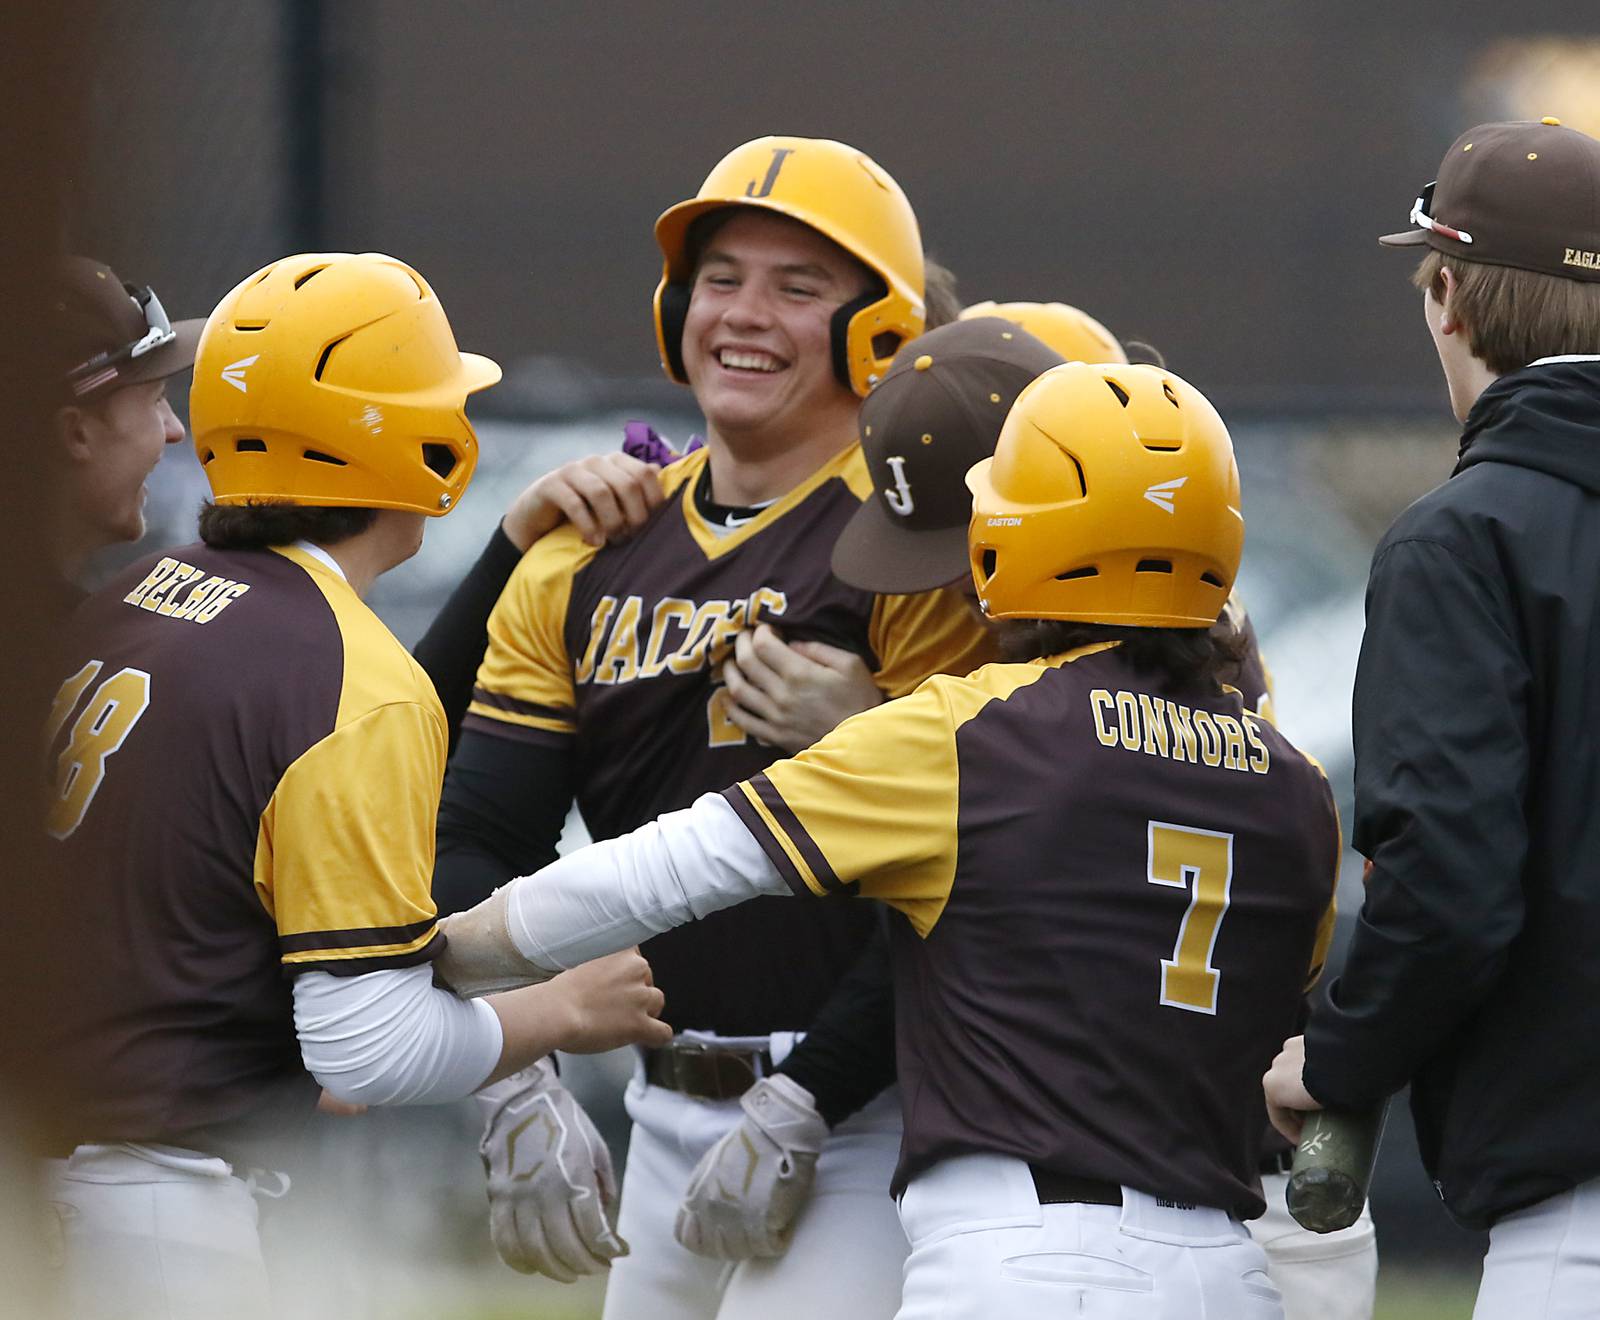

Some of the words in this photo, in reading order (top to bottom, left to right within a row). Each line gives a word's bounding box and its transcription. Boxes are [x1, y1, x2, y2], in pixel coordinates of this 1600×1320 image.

[745, 148, 795, 198] J
[884, 456, 914, 516] J
[987, 517, 1022, 527] EASTON
[1089, 688, 1270, 775] CONNORS
[1147, 820, 1233, 1016] 7
